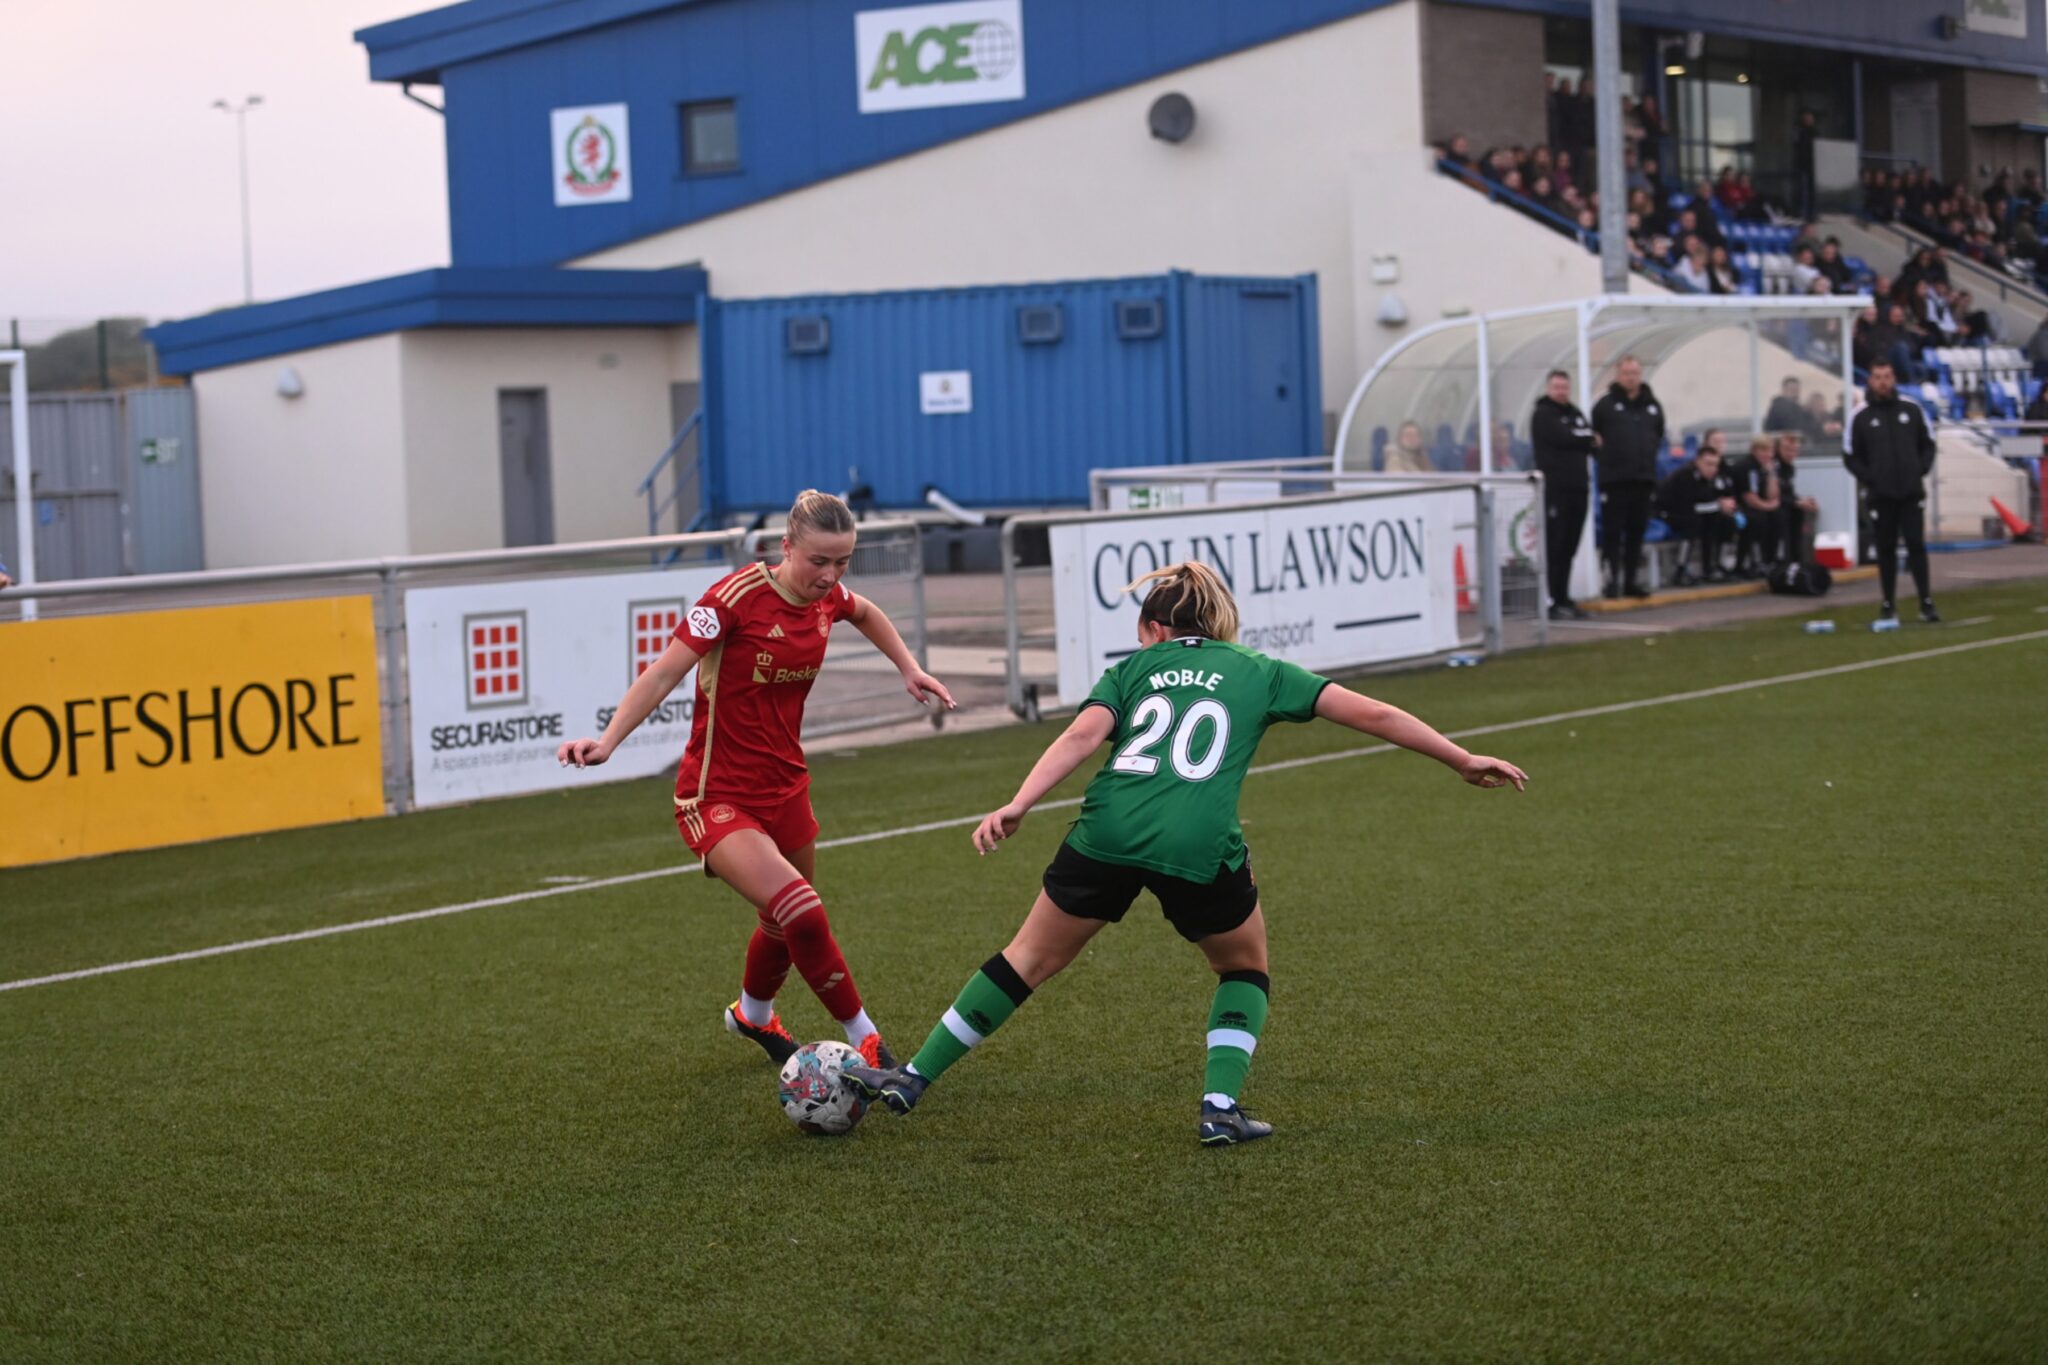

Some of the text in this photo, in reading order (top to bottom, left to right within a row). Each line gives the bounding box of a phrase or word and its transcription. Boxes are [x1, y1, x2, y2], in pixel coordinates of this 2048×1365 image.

[867, 20, 981, 91] ACE
[1249, 516, 1424, 594] LAWSON
[1237, 615, 1315, 656] ransport
[1149, 668, 1224, 692] NOBLE
[0, 673, 361, 783] OFFSHORE
[430, 713, 564, 751] SECURASTORE
[1111, 693, 1231, 783] 20
